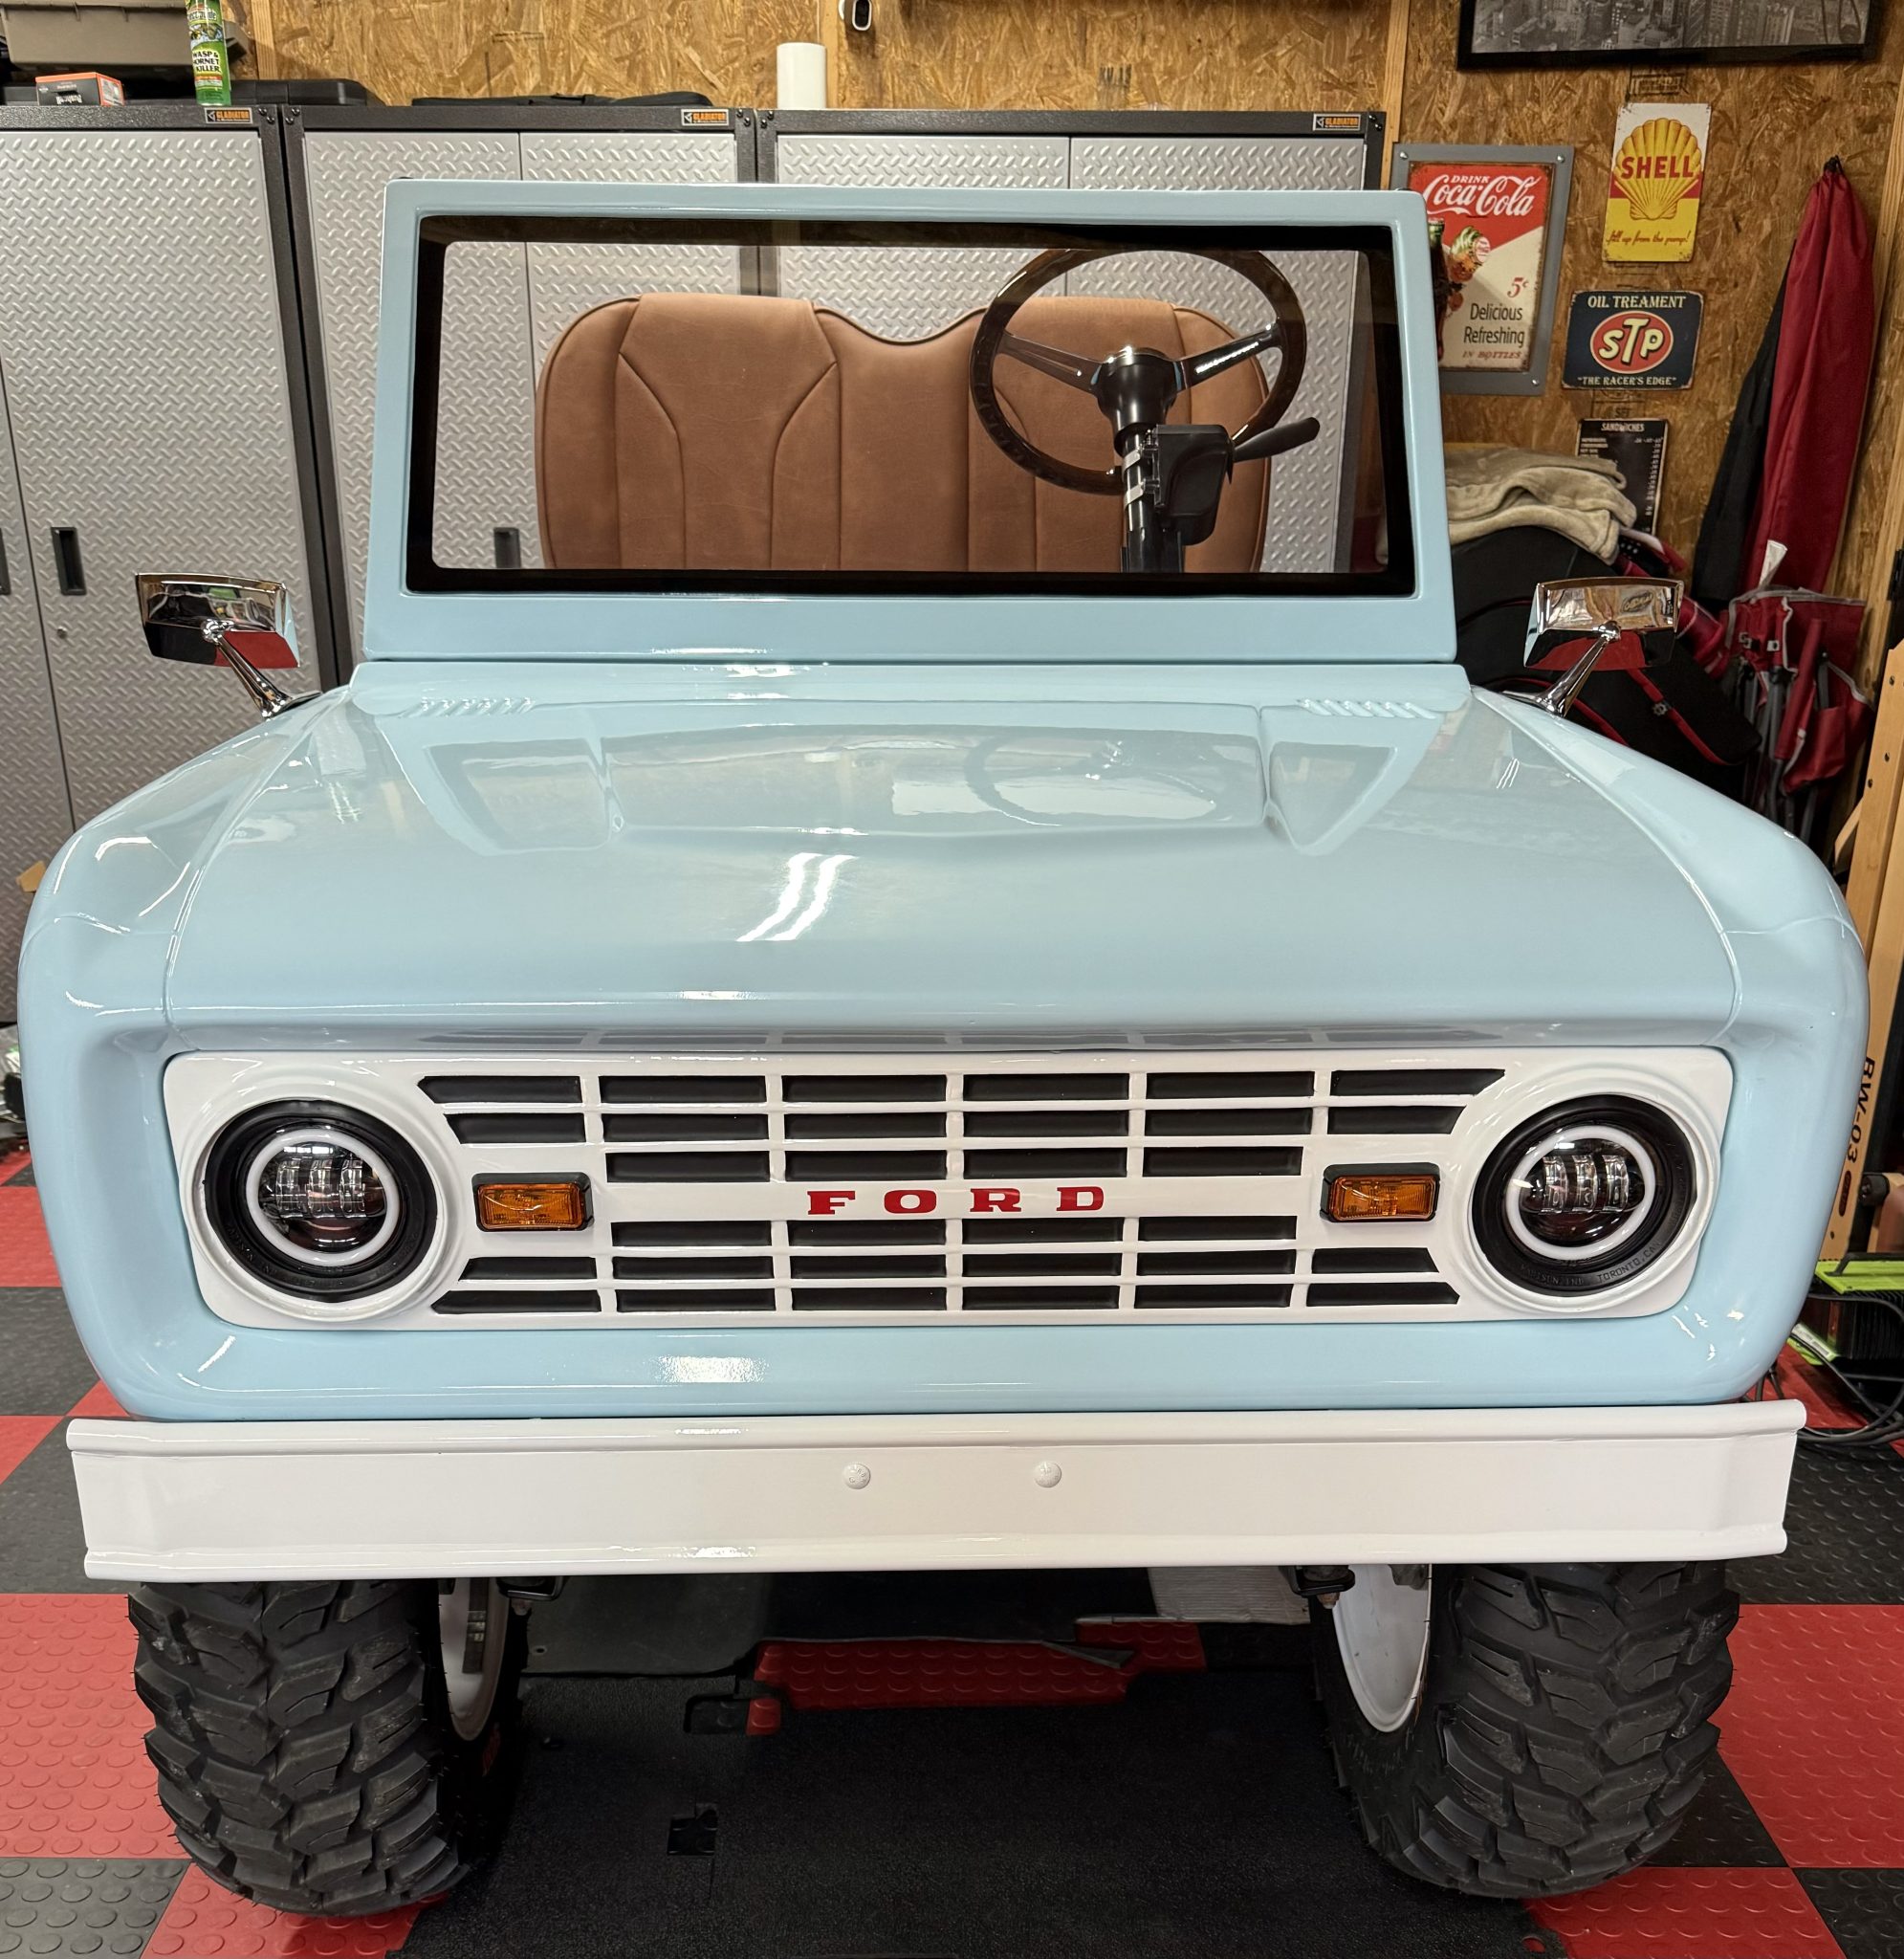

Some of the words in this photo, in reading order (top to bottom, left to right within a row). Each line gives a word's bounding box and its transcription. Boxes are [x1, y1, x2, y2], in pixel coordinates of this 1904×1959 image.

[1621, 155, 1694, 179] SHELL
[1451, 175, 1490, 184] DRINK
[1470, 302, 1523, 320] Delicious
[1587, 296, 1609, 308] OIL
[1612, 296, 1686, 308] TREAMENT
[1463, 325, 1525, 349] Refreshing
[1598, 318, 1665, 365] STP
[1477, 350, 1522, 360] BOTTLES
[806, 1185, 1105, 1216] FORD
